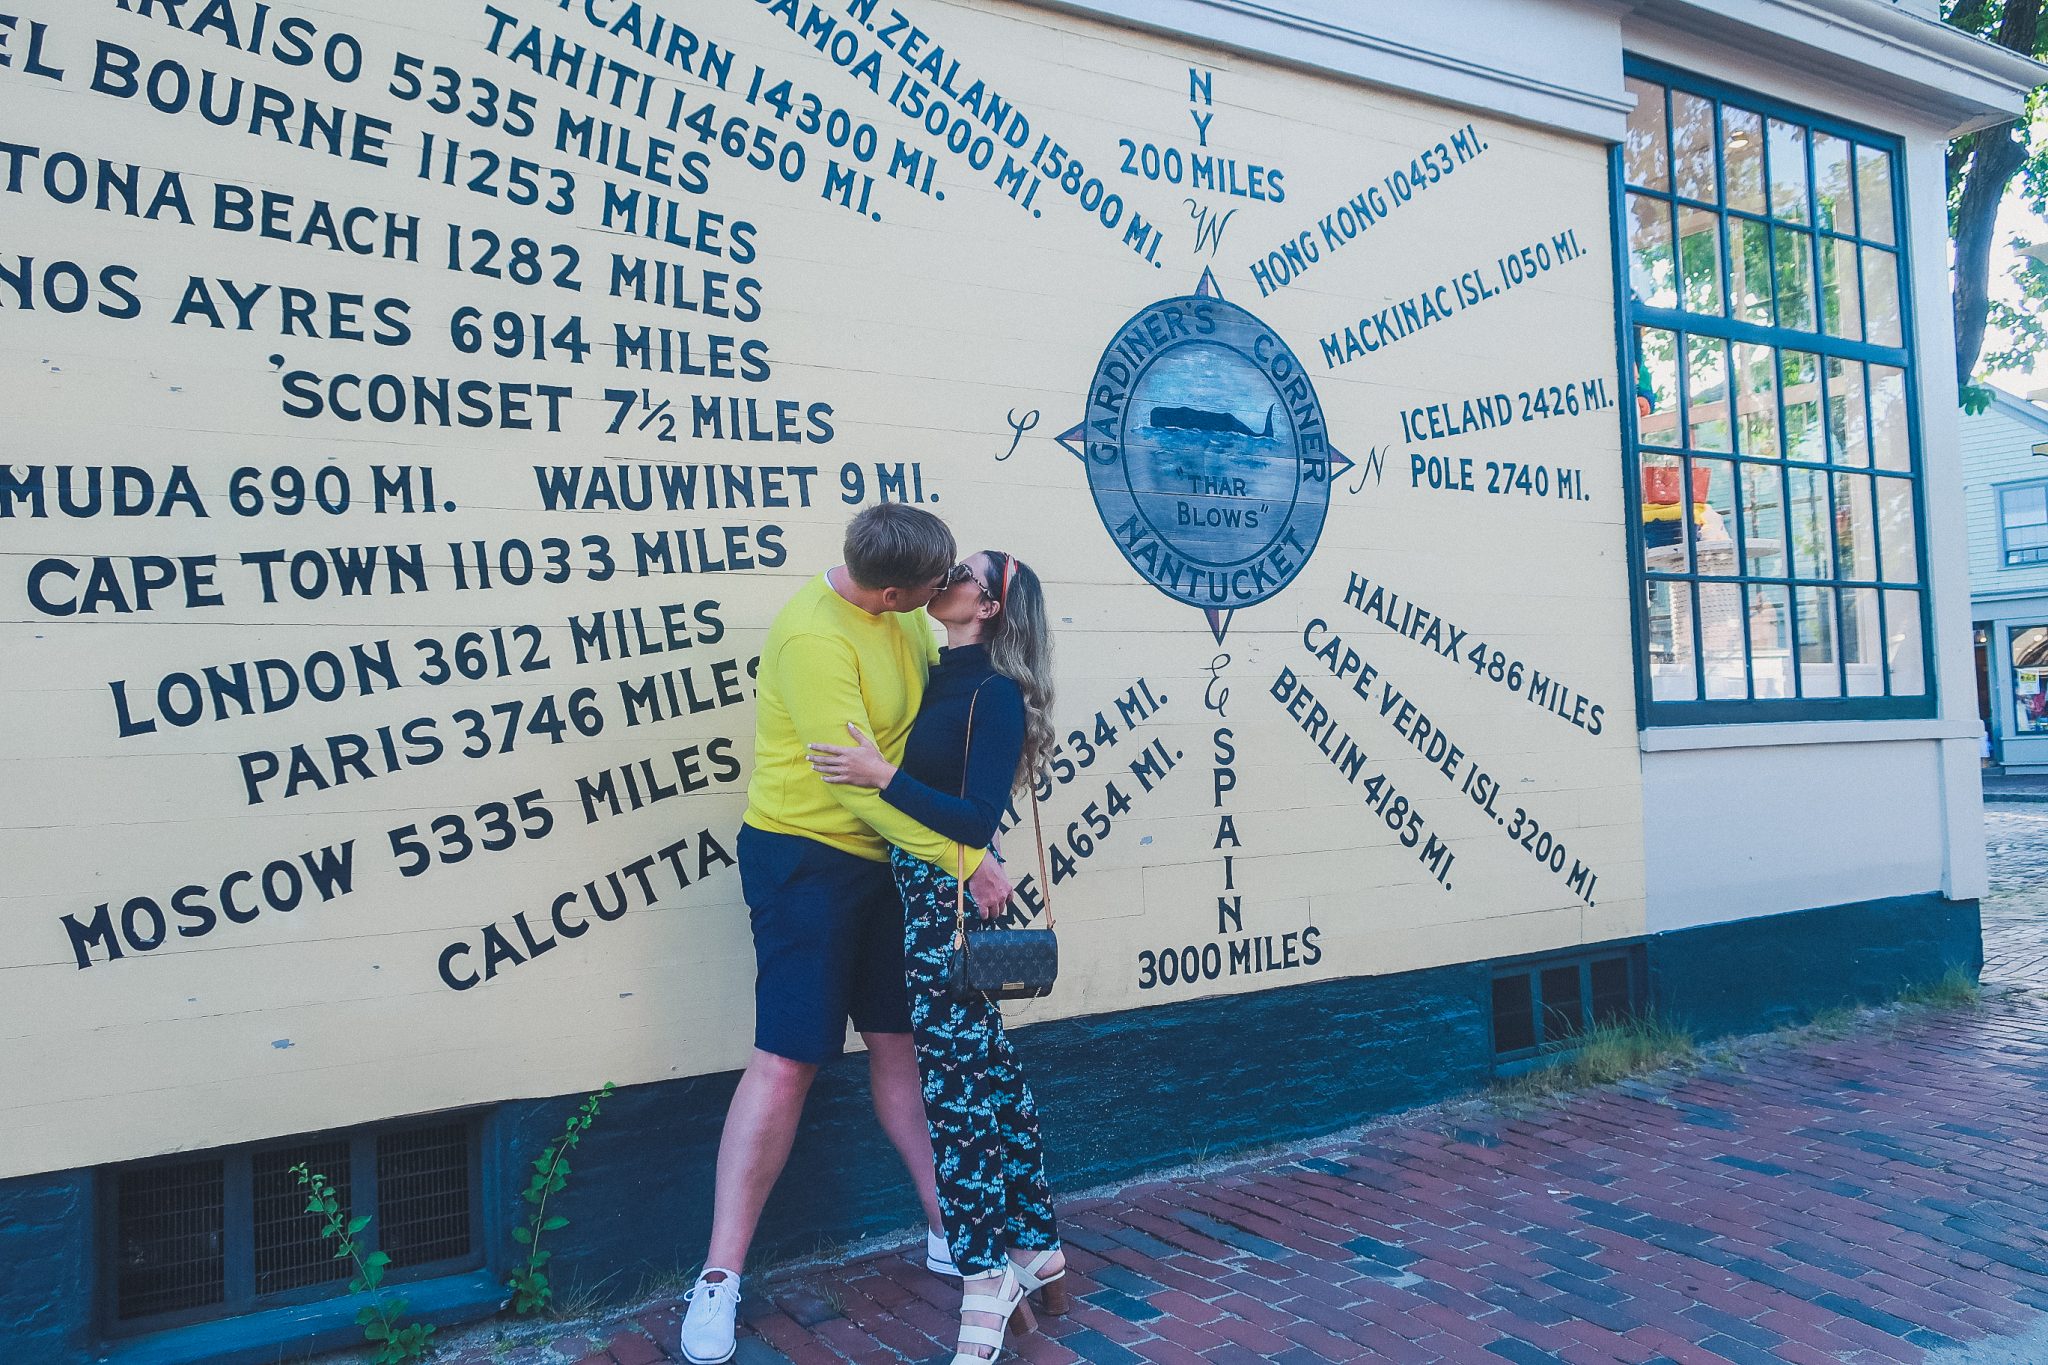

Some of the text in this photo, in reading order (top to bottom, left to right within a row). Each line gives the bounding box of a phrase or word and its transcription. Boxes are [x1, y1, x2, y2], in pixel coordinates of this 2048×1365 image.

[90, 40, 392, 168] BOURNE
[418, 131, 575, 215] 11253
[601, 181, 757, 264] MILES
[116, 0, 710, 194] AISO 5335 MILES
[485, 4, 881, 222] TAHITI 14650 MI.
[558, 0, 944, 201] CAIRN 14300 MI.
[754, 0, 1041, 218] AMOA 15000 MI.
[0, 141, 762, 322] TONA BEACH 1282 MILES
[1030, 134, 1123, 228] 15800
[1122, 212, 1163, 268] MI.
[1119, 139, 1285, 203] 200 MILES
[1249, 124, 1488, 298] HONG KONG 10453 MI.
[171, 276, 411, 346] AYRES
[451, 306, 591, 364] 6914
[613, 323, 770, 382] MILES
[1319, 229, 1586, 369] MACKINAC ISL. 1050 MI.
[691, 395, 834, 444] MILES
[1253, 333, 1326, 483] CORNER
[1400, 378, 1613, 443] ICELAND 2426 MI.
[1411, 454, 1589, 501] POLE 2740 MI.
[0, 465, 456, 518] MUDA 690 MI.
[533, 462, 940, 511] WAUWINET 9 MI.
[1116, 513, 1306, 601] NANTUCKET
[27, 525, 787, 616] CAPE TOWN 11033 MILES
[108, 600, 724, 738] LONDON 3612 MILES
[1114, 677, 1167, 731] MI.
[1343, 571, 1604, 735] HALIFAX 486 MILES
[238, 718, 443, 805] PARIS
[452, 688, 603, 758] 3746
[1049, 781, 1132, 885] 4654
[1129, 737, 1183, 793] MI.
[1270, 665, 1455, 891] BERLIN 4185 MI.
[1304, 619, 1598, 907] CAPE VERDE ISL. 3200 MI.
[59, 737, 741, 970] MOSCOW 5335 MILES
[1213, 728, 1243, 934] SPAIN
[438, 828, 737, 991] CALCUTTA
[1139, 924, 1321, 989] 3000 MILES
